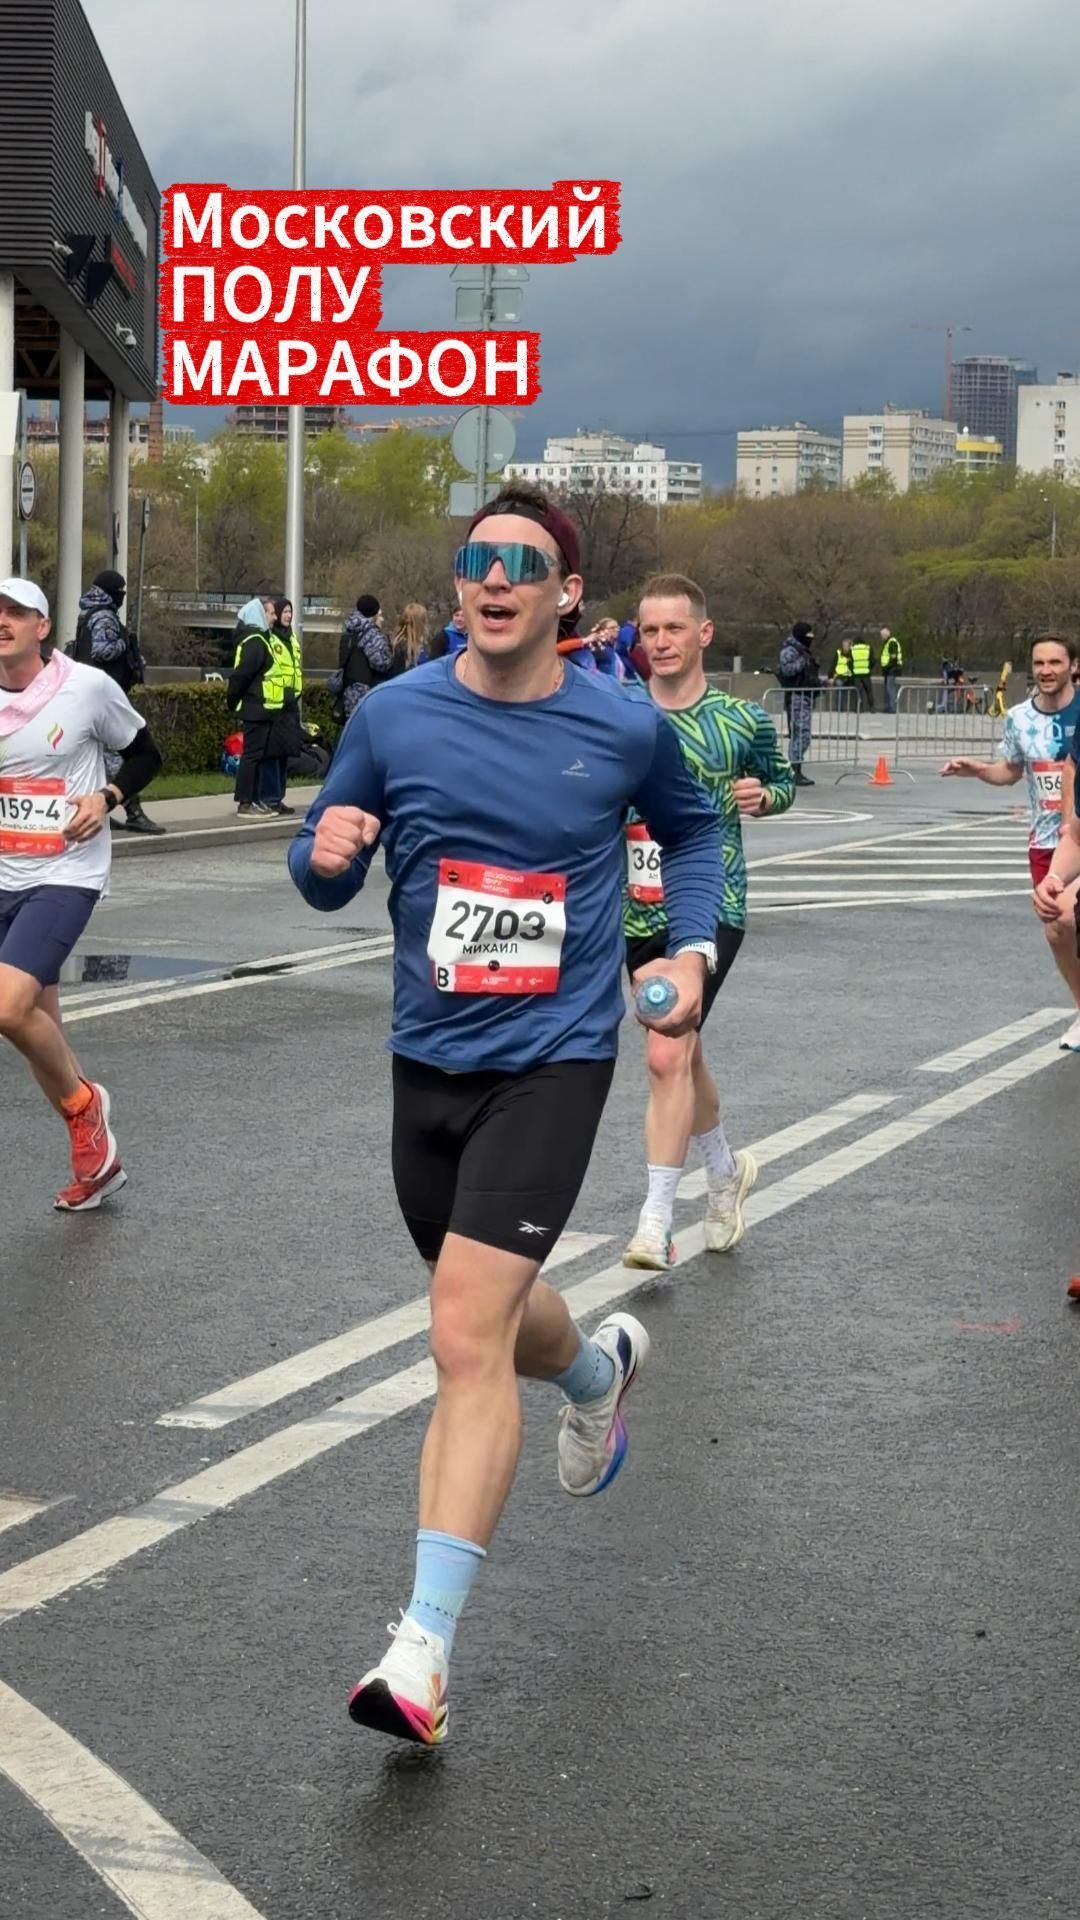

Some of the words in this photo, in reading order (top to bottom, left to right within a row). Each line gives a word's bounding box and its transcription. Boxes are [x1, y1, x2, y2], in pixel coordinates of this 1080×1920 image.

[0, 796, 60, 821] 159-4
[445, 900, 546, 942] 2703
[462, 943, 518, 955] МИХАИЛ
[437, 967, 449, 988] B
